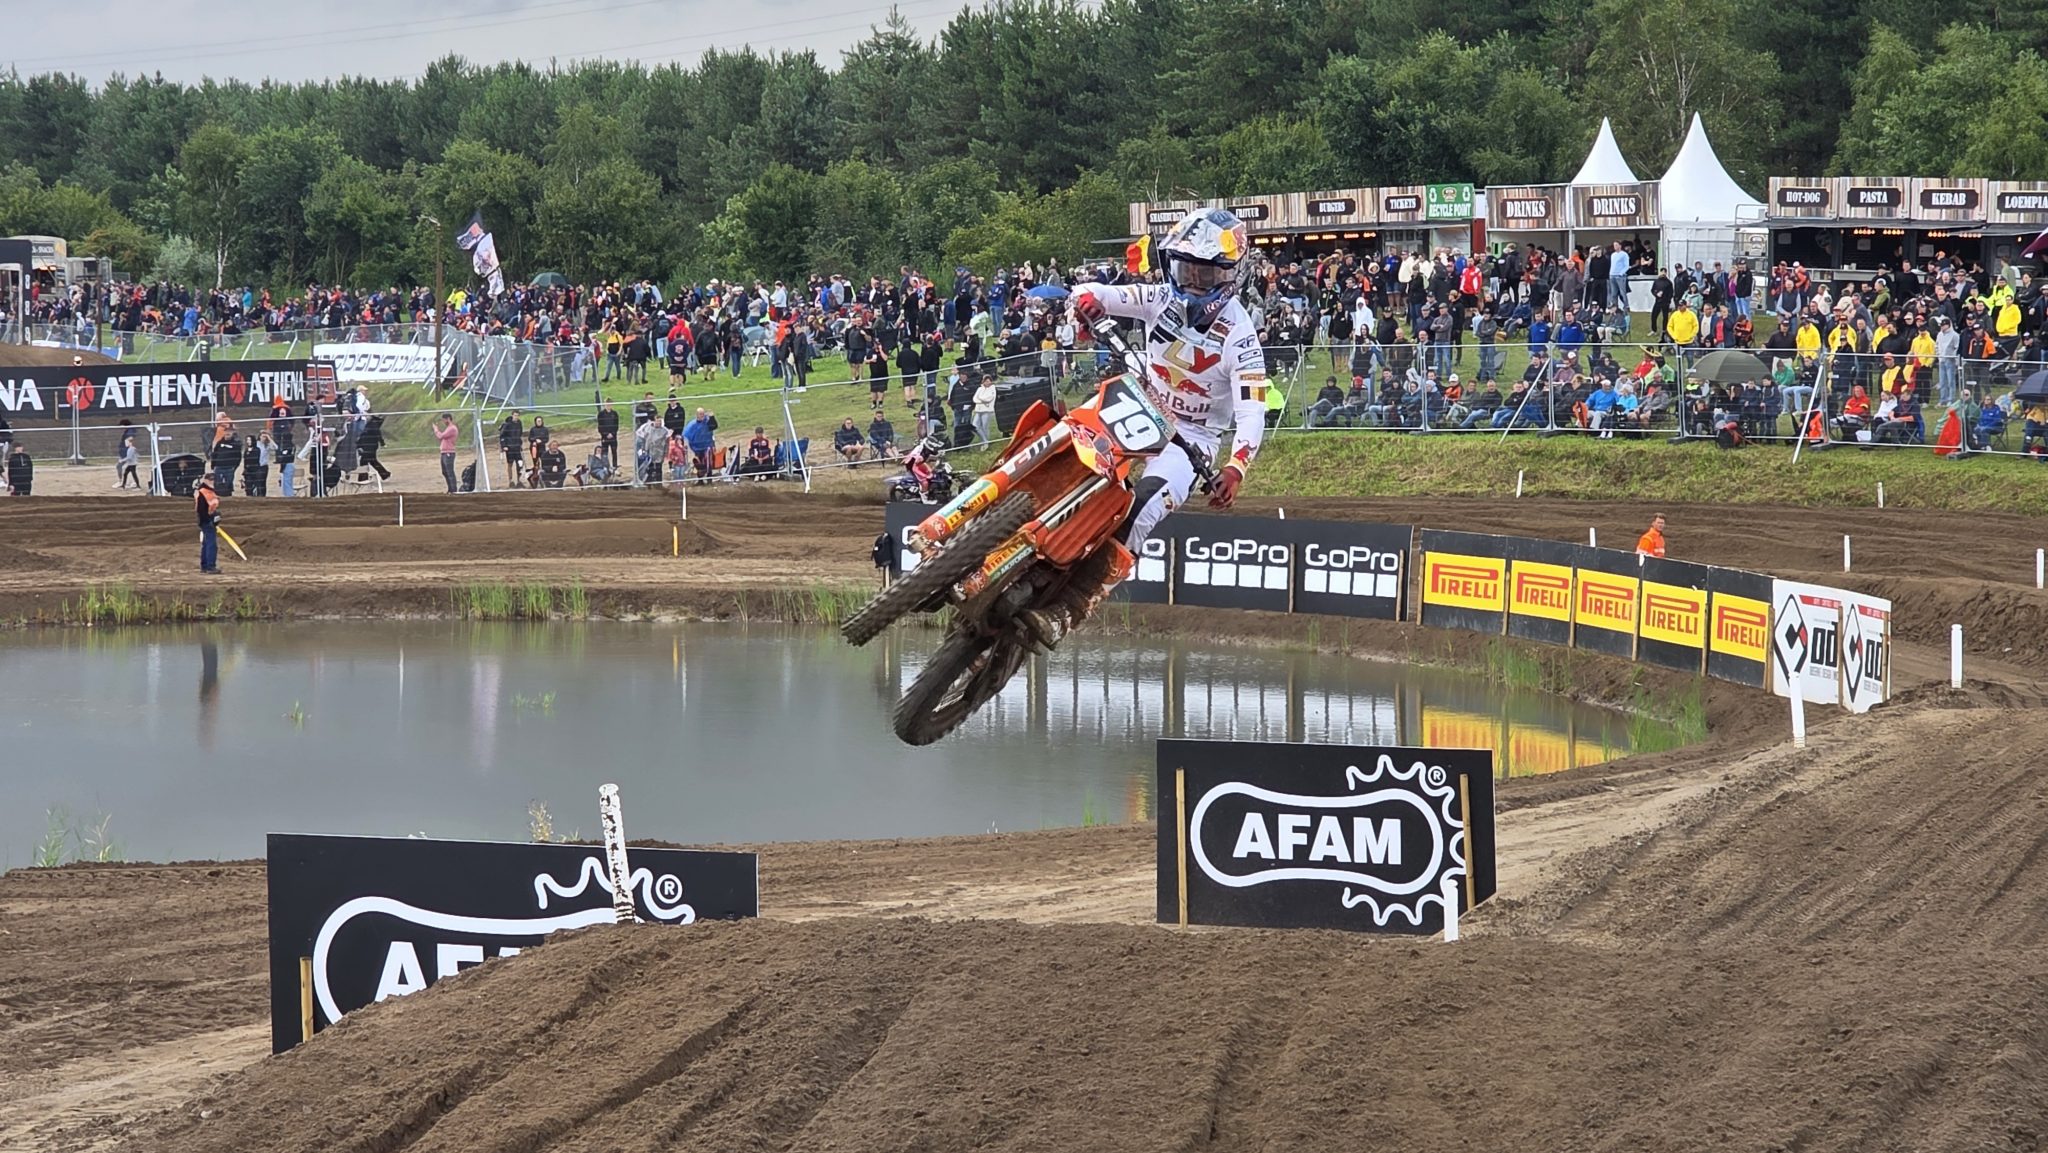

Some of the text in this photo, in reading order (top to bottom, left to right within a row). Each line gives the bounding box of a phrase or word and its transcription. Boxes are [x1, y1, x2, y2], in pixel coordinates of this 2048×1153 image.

[1318, 202, 1346, 213] BURGERS
[1389, 198, 1416, 209] TICKETS
[1428, 203, 1472, 217] RECYCLE POINT
[1506, 200, 1545, 218] DRINKS
[1593, 197, 1636, 216] DRINKS
[1786, 191, 1820, 203] HOT-DOG
[1860, 191, 1888, 203] PASTA
[1931, 192, 1966, 206] KEBAB
[100, 372, 214, 409] ATHENA
[249, 370, 304, 403] ATHENA
[1172, 396, 1211, 414] Bull
[1099, 391, 1161, 451] 19
[1185, 536, 1289, 563] GoPro
[1304, 543, 1399, 572] GoPro
[1431, 562, 1498, 600] PIRELLI
[1517, 571, 1569, 610] PIRELLI
[1581, 581, 1633, 621] PIRELLI
[1645, 593, 1700, 636] PIRELLI
[1717, 605, 1766, 649] PIRELLI
[1232, 812, 1402, 865] AFAM
